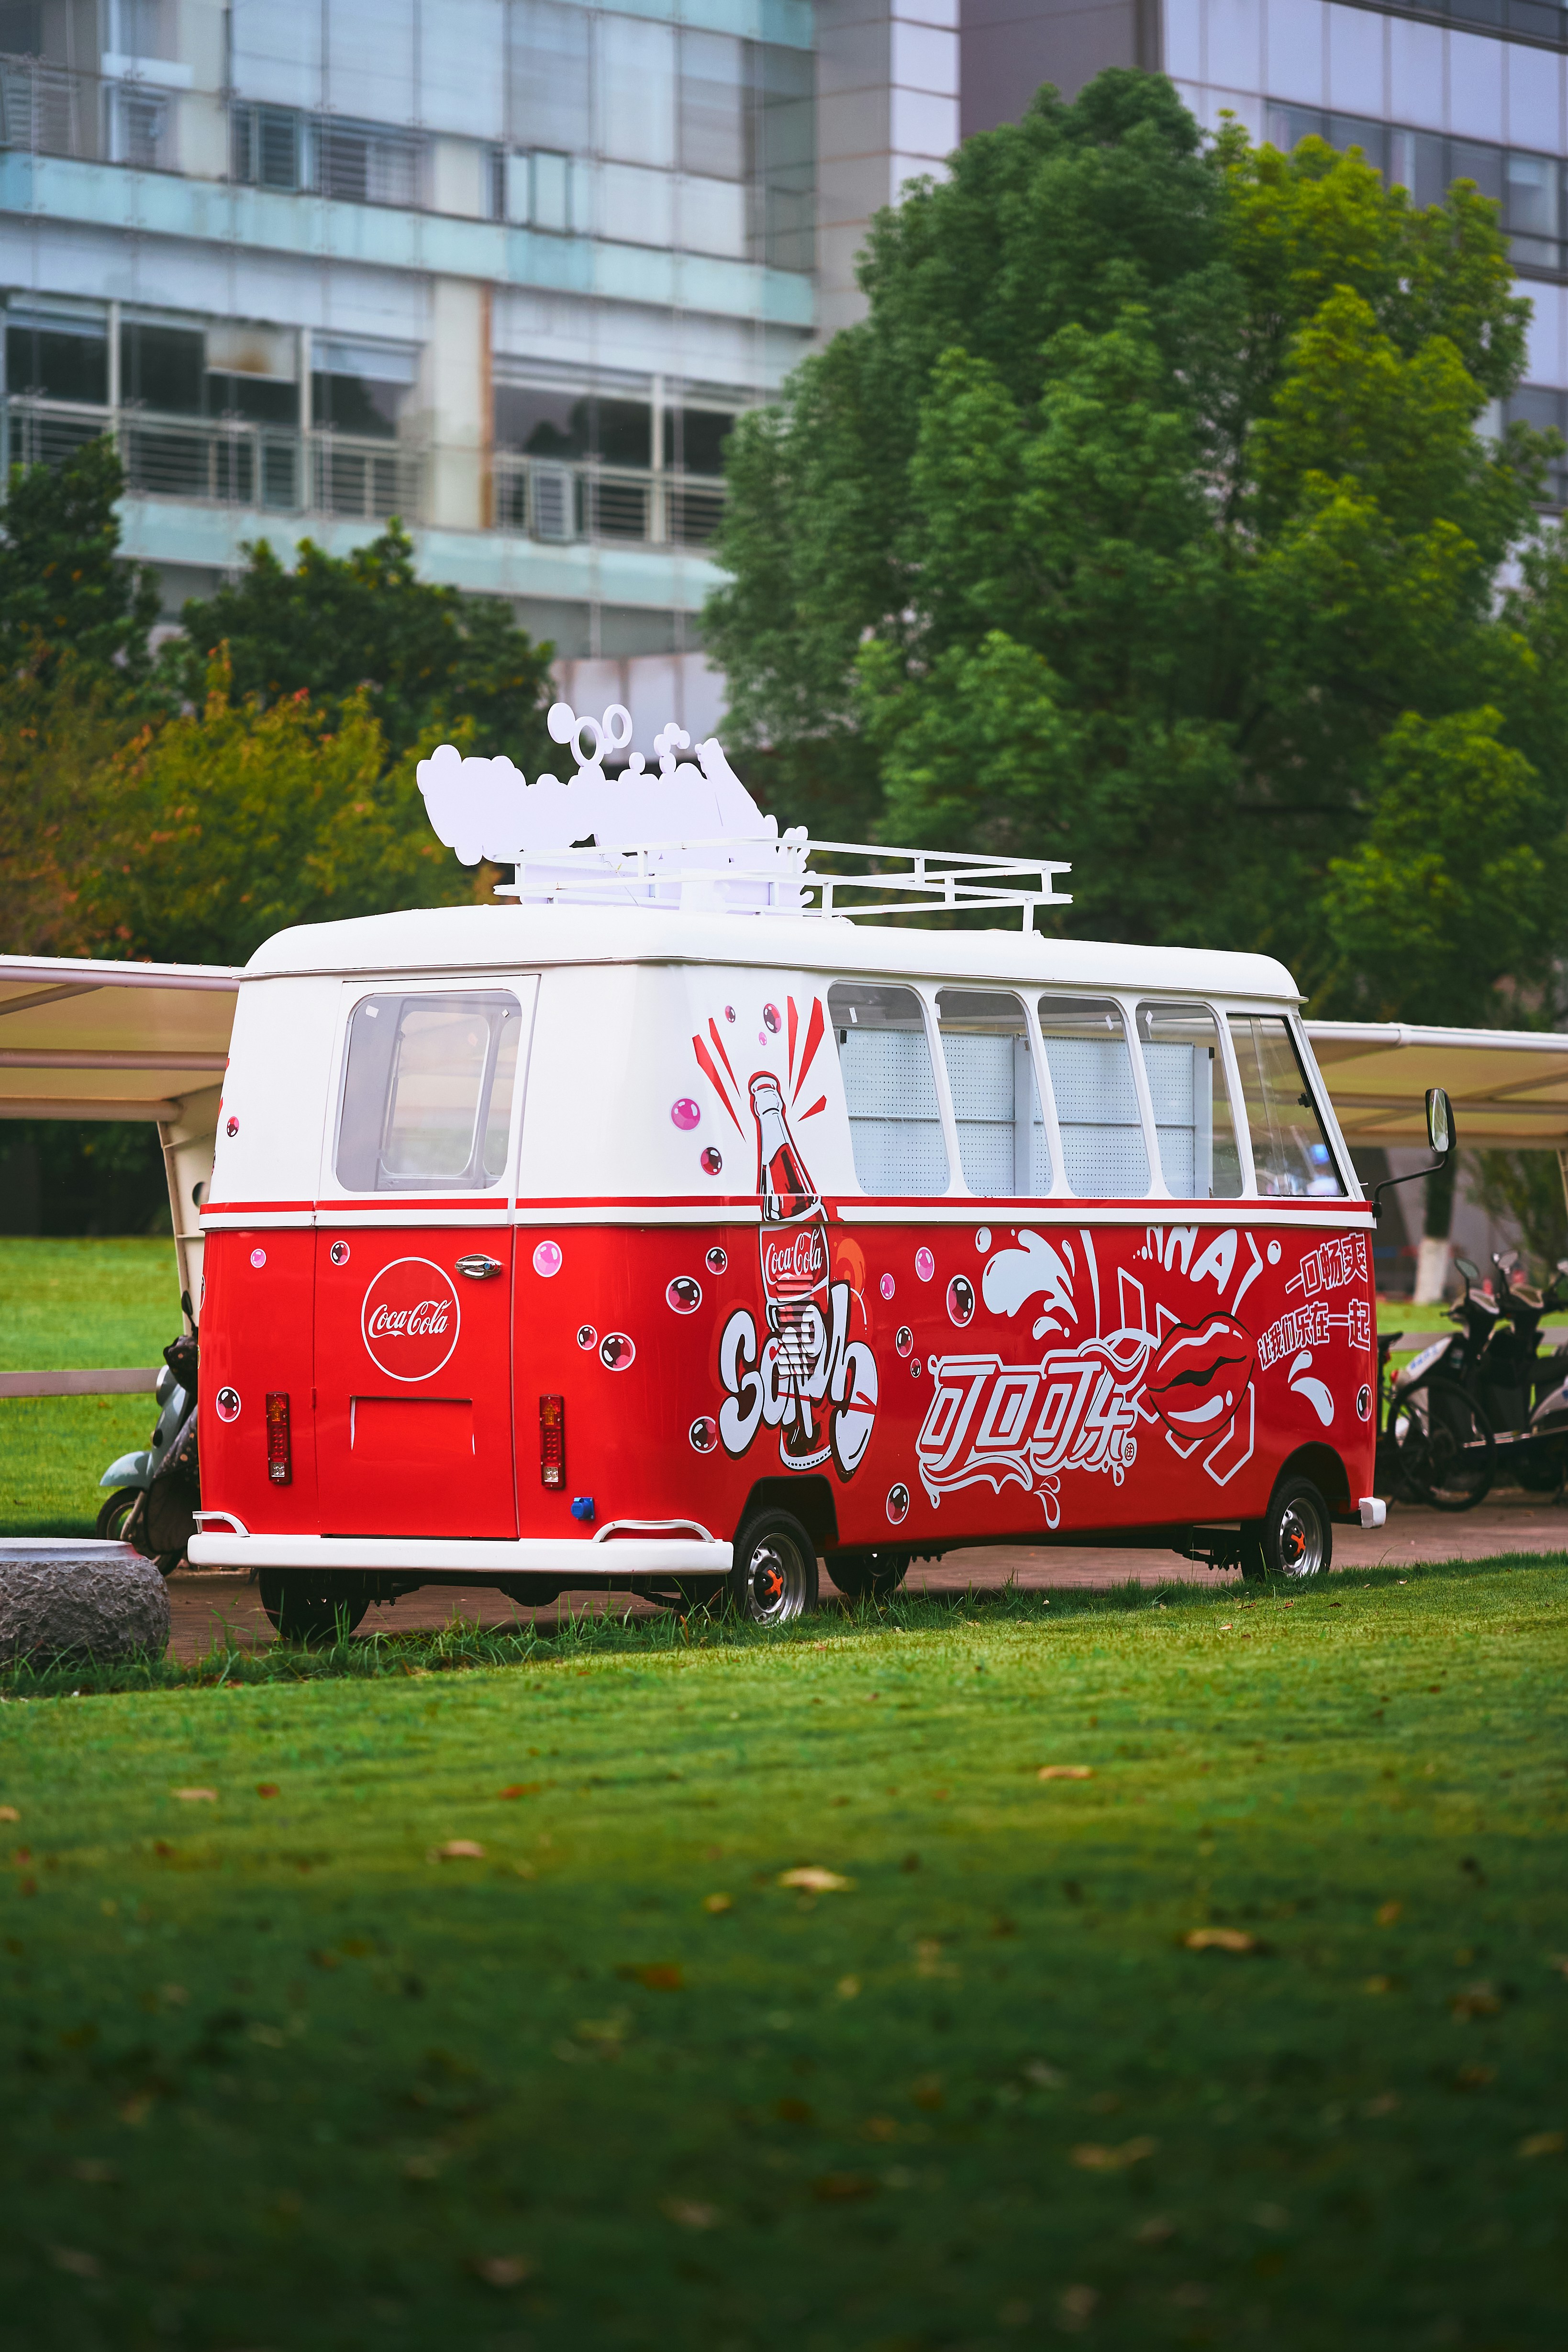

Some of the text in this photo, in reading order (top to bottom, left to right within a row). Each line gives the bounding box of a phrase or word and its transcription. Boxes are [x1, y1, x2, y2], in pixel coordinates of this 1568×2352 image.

[766, 1228, 823, 1285] Coca-Cola
[1285, 1233, 1368, 1297] 一口畅爽
[368, 1300, 453, 1338] Coca-Cola
[1257, 1299, 1370, 1371] 让我们乐在一起
[918, 1358, 1135, 1474] 可口可乐
